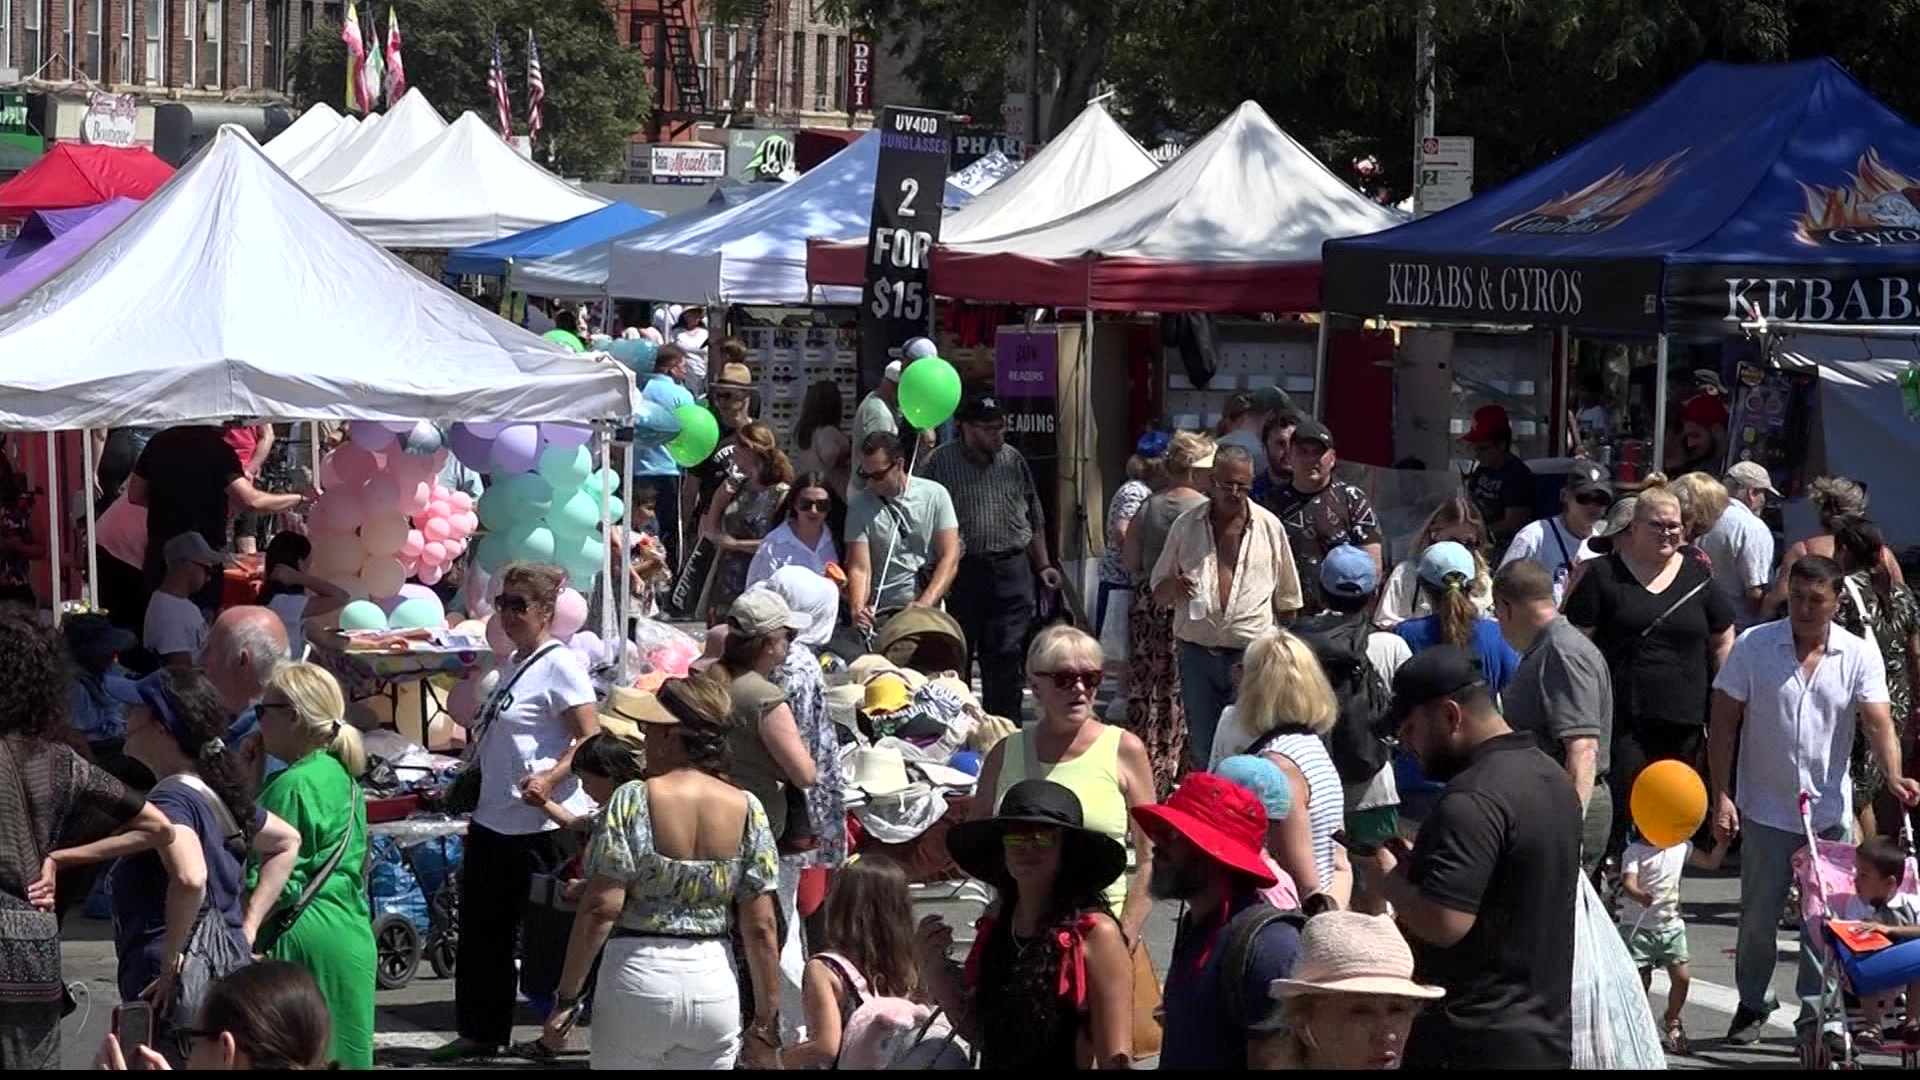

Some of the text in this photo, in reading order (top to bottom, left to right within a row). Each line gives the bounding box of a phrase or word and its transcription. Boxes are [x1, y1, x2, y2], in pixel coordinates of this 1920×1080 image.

[881, 132, 946, 154] SUNGLASSES
[895, 113, 938, 134] UV400
[897, 177, 919, 216] 2
[873, 227, 932, 269] FOR
[871, 276, 922, 320] $15
[1387, 263, 1583, 315] KEBABS & GYROS
[1722, 277, 1920, 322] KEBAB
[1008, 370, 1044, 381] READERS
